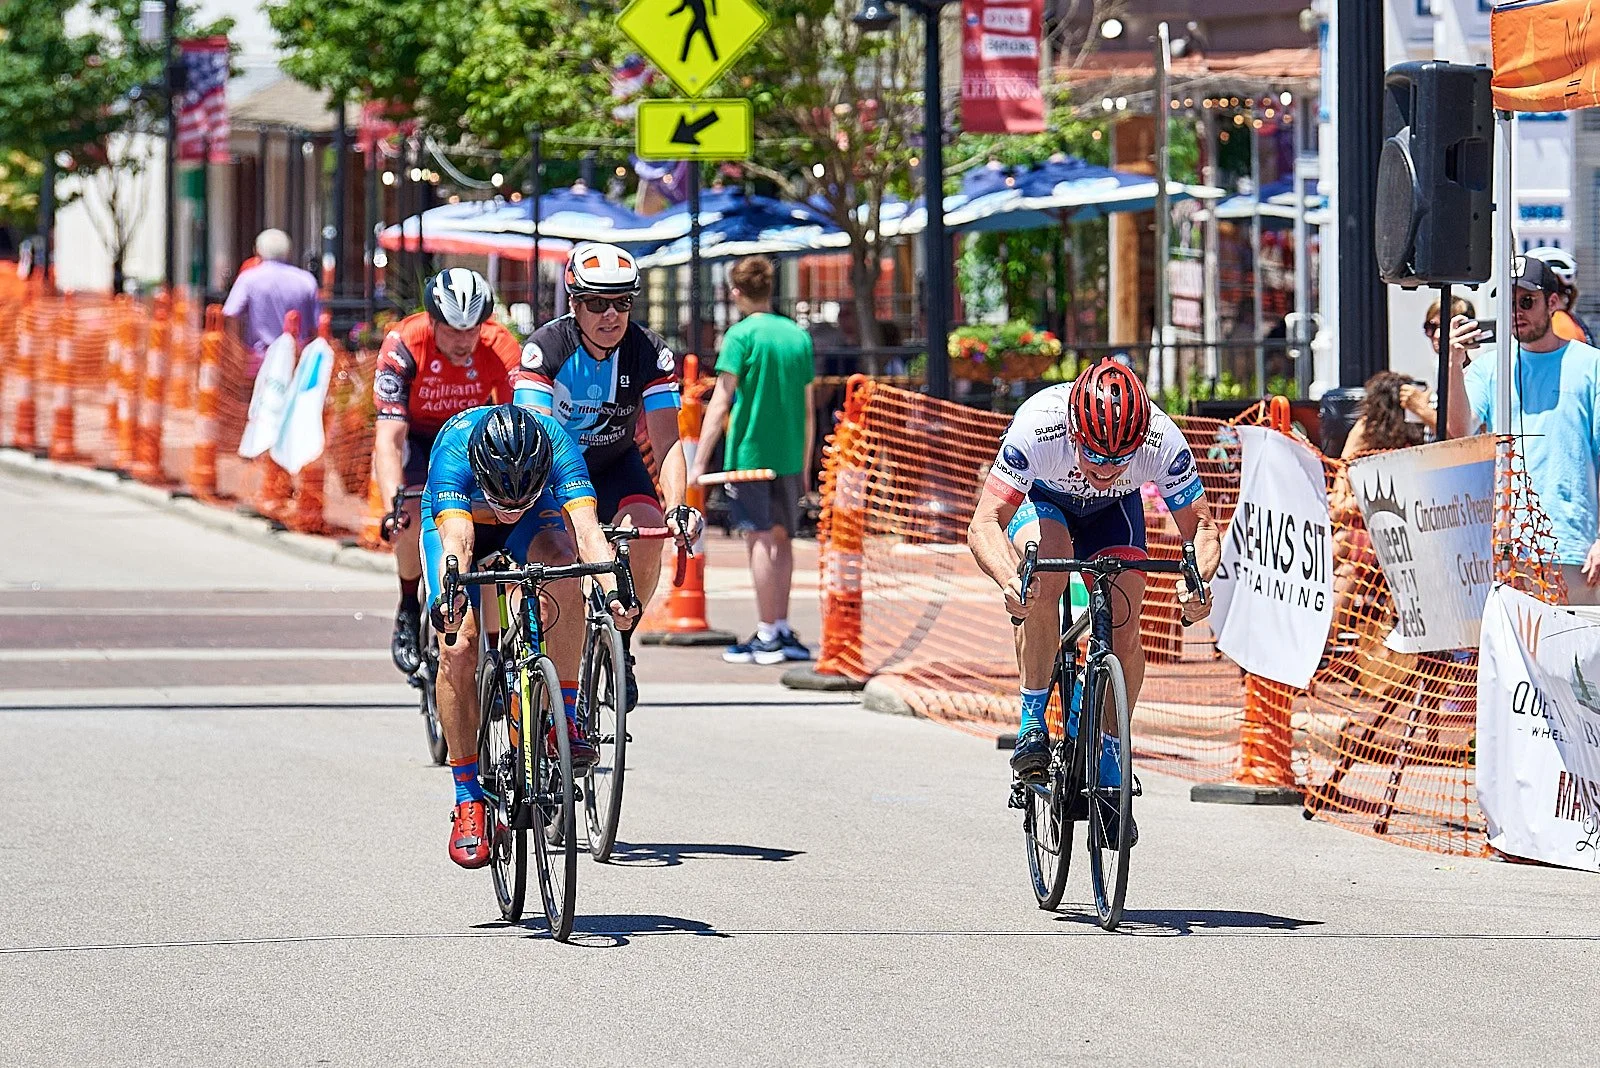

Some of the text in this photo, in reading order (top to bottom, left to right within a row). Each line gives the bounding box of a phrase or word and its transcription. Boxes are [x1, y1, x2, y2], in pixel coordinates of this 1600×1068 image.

[418, 382, 483, 400] Brilliant
[559, 400, 575, 414] the
[1414, 494, 1467, 533] Cincinnati's
[1302, 519, 1326, 584] SIT
